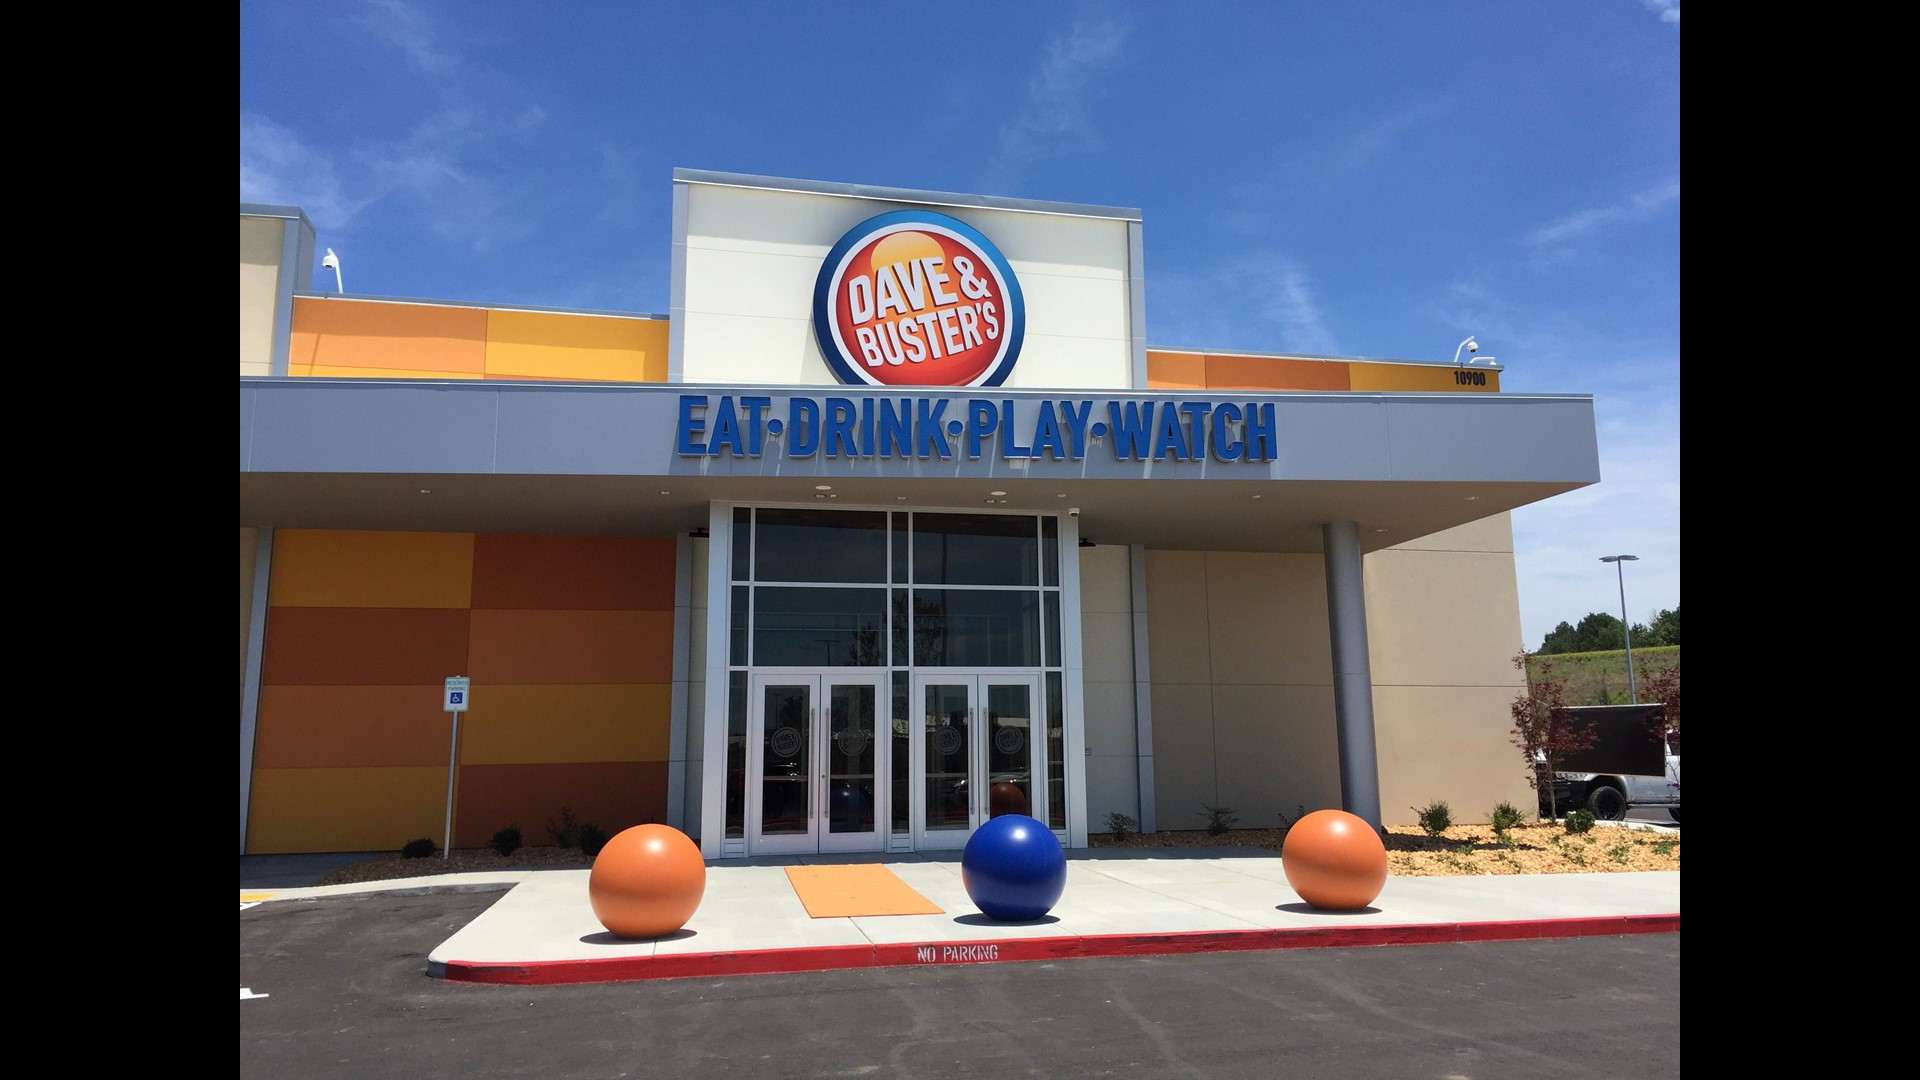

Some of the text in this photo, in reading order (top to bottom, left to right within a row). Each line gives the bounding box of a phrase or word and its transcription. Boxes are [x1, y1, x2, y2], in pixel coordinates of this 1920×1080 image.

[849, 255, 993, 326] DAVE &
[855, 301, 999, 367] BUSTER'S
[1453, 370, 1486, 386] 10900
[678, 395, 1277, 463] EAT DRINK PLAY WATCH
[917, 944, 998, 962] NO PARKING
